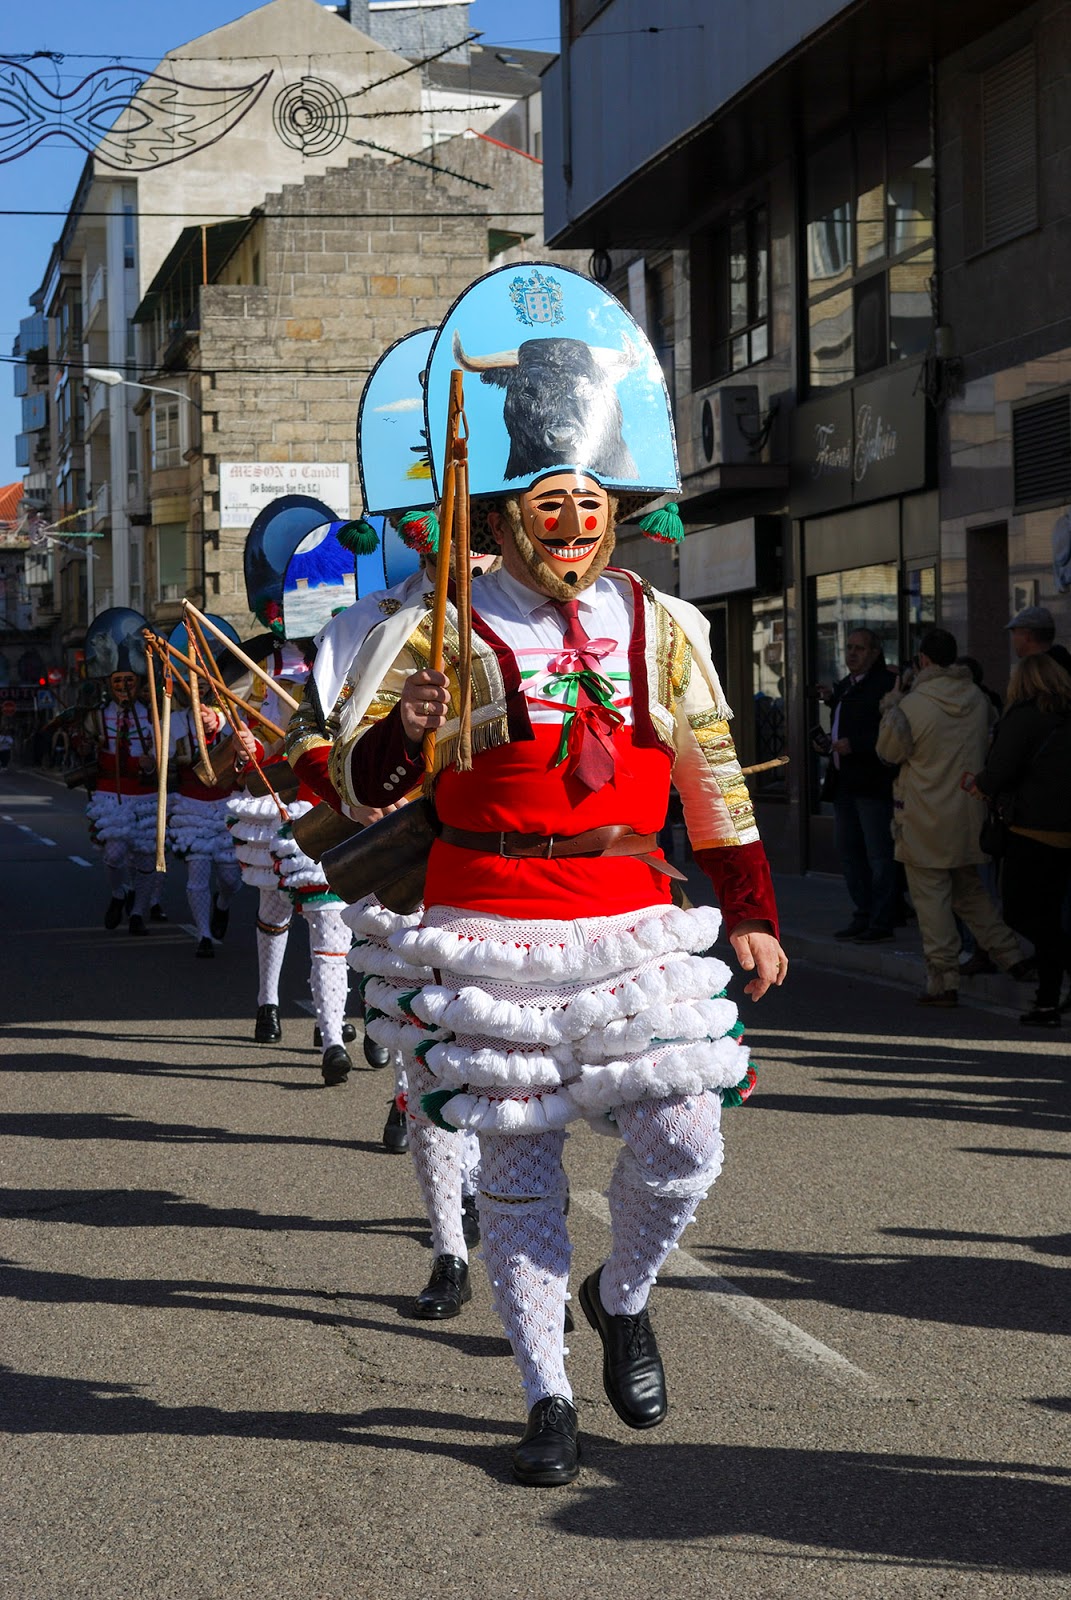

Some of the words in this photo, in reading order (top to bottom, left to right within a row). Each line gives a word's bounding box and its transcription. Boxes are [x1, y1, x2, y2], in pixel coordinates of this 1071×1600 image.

[301, 465, 340, 478] Candil
[250, 483, 260, 495] (De
[261, 483, 285, 495] Bodegas
[286, 483, 297, 493] San
